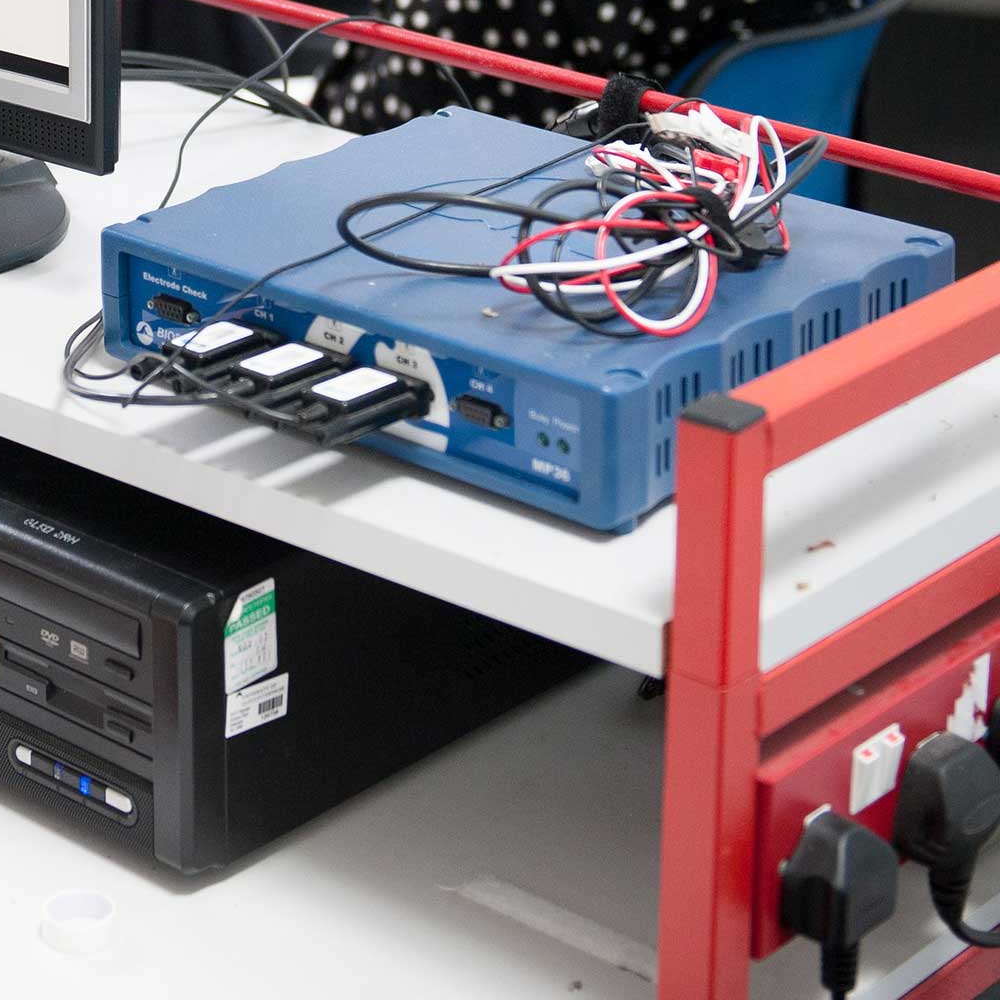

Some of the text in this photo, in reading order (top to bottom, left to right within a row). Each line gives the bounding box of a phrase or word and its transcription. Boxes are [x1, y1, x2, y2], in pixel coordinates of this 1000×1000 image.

[143, 271, 208, 301] Electrode Check
[254, 308, 268, 319] CH
[157, 326, 180, 341] BIO
[323, 331, 345, 346] CH 2
[396, 354, 411, 367] CH
[40, 628, 60, 642] DVD
